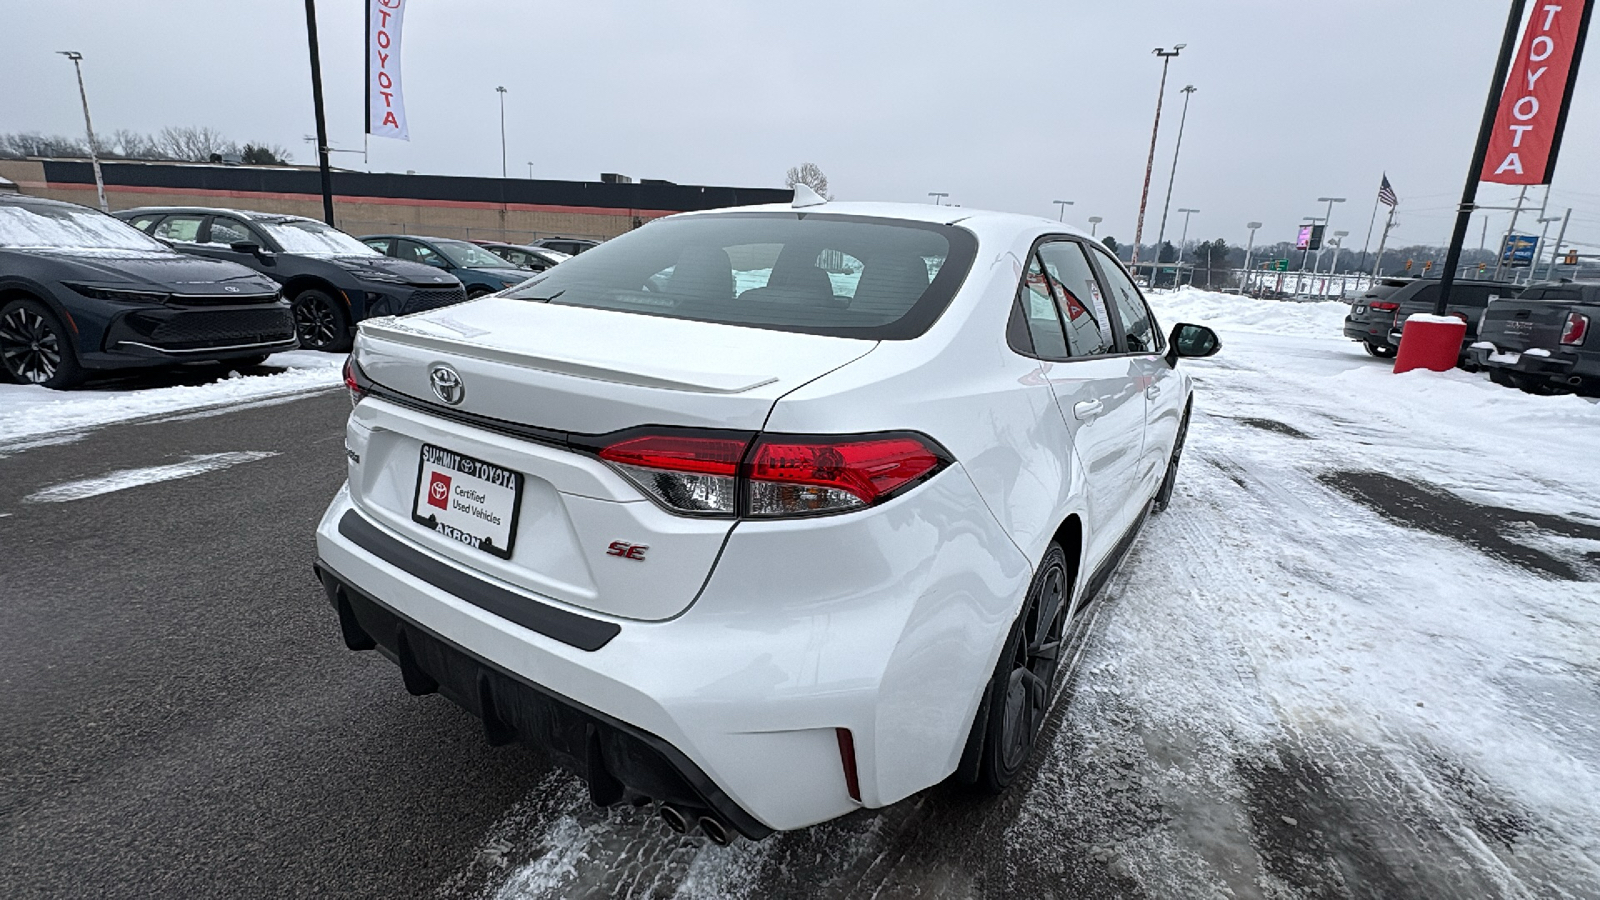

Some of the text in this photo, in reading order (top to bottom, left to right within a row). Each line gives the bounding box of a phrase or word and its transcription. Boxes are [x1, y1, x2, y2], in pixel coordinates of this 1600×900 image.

[377, 9, 399, 128] TOYOTA
[1494, 5, 1562, 174] TOYOTA
[423, 446, 516, 490] SUMMIT TOYOTA
[455, 485, 486, 504] Certified
[453, 499, 501, 526] Used Vehicles
[435, 522, 481, 549] AKRON
[606, 540, 649, 562] SE
